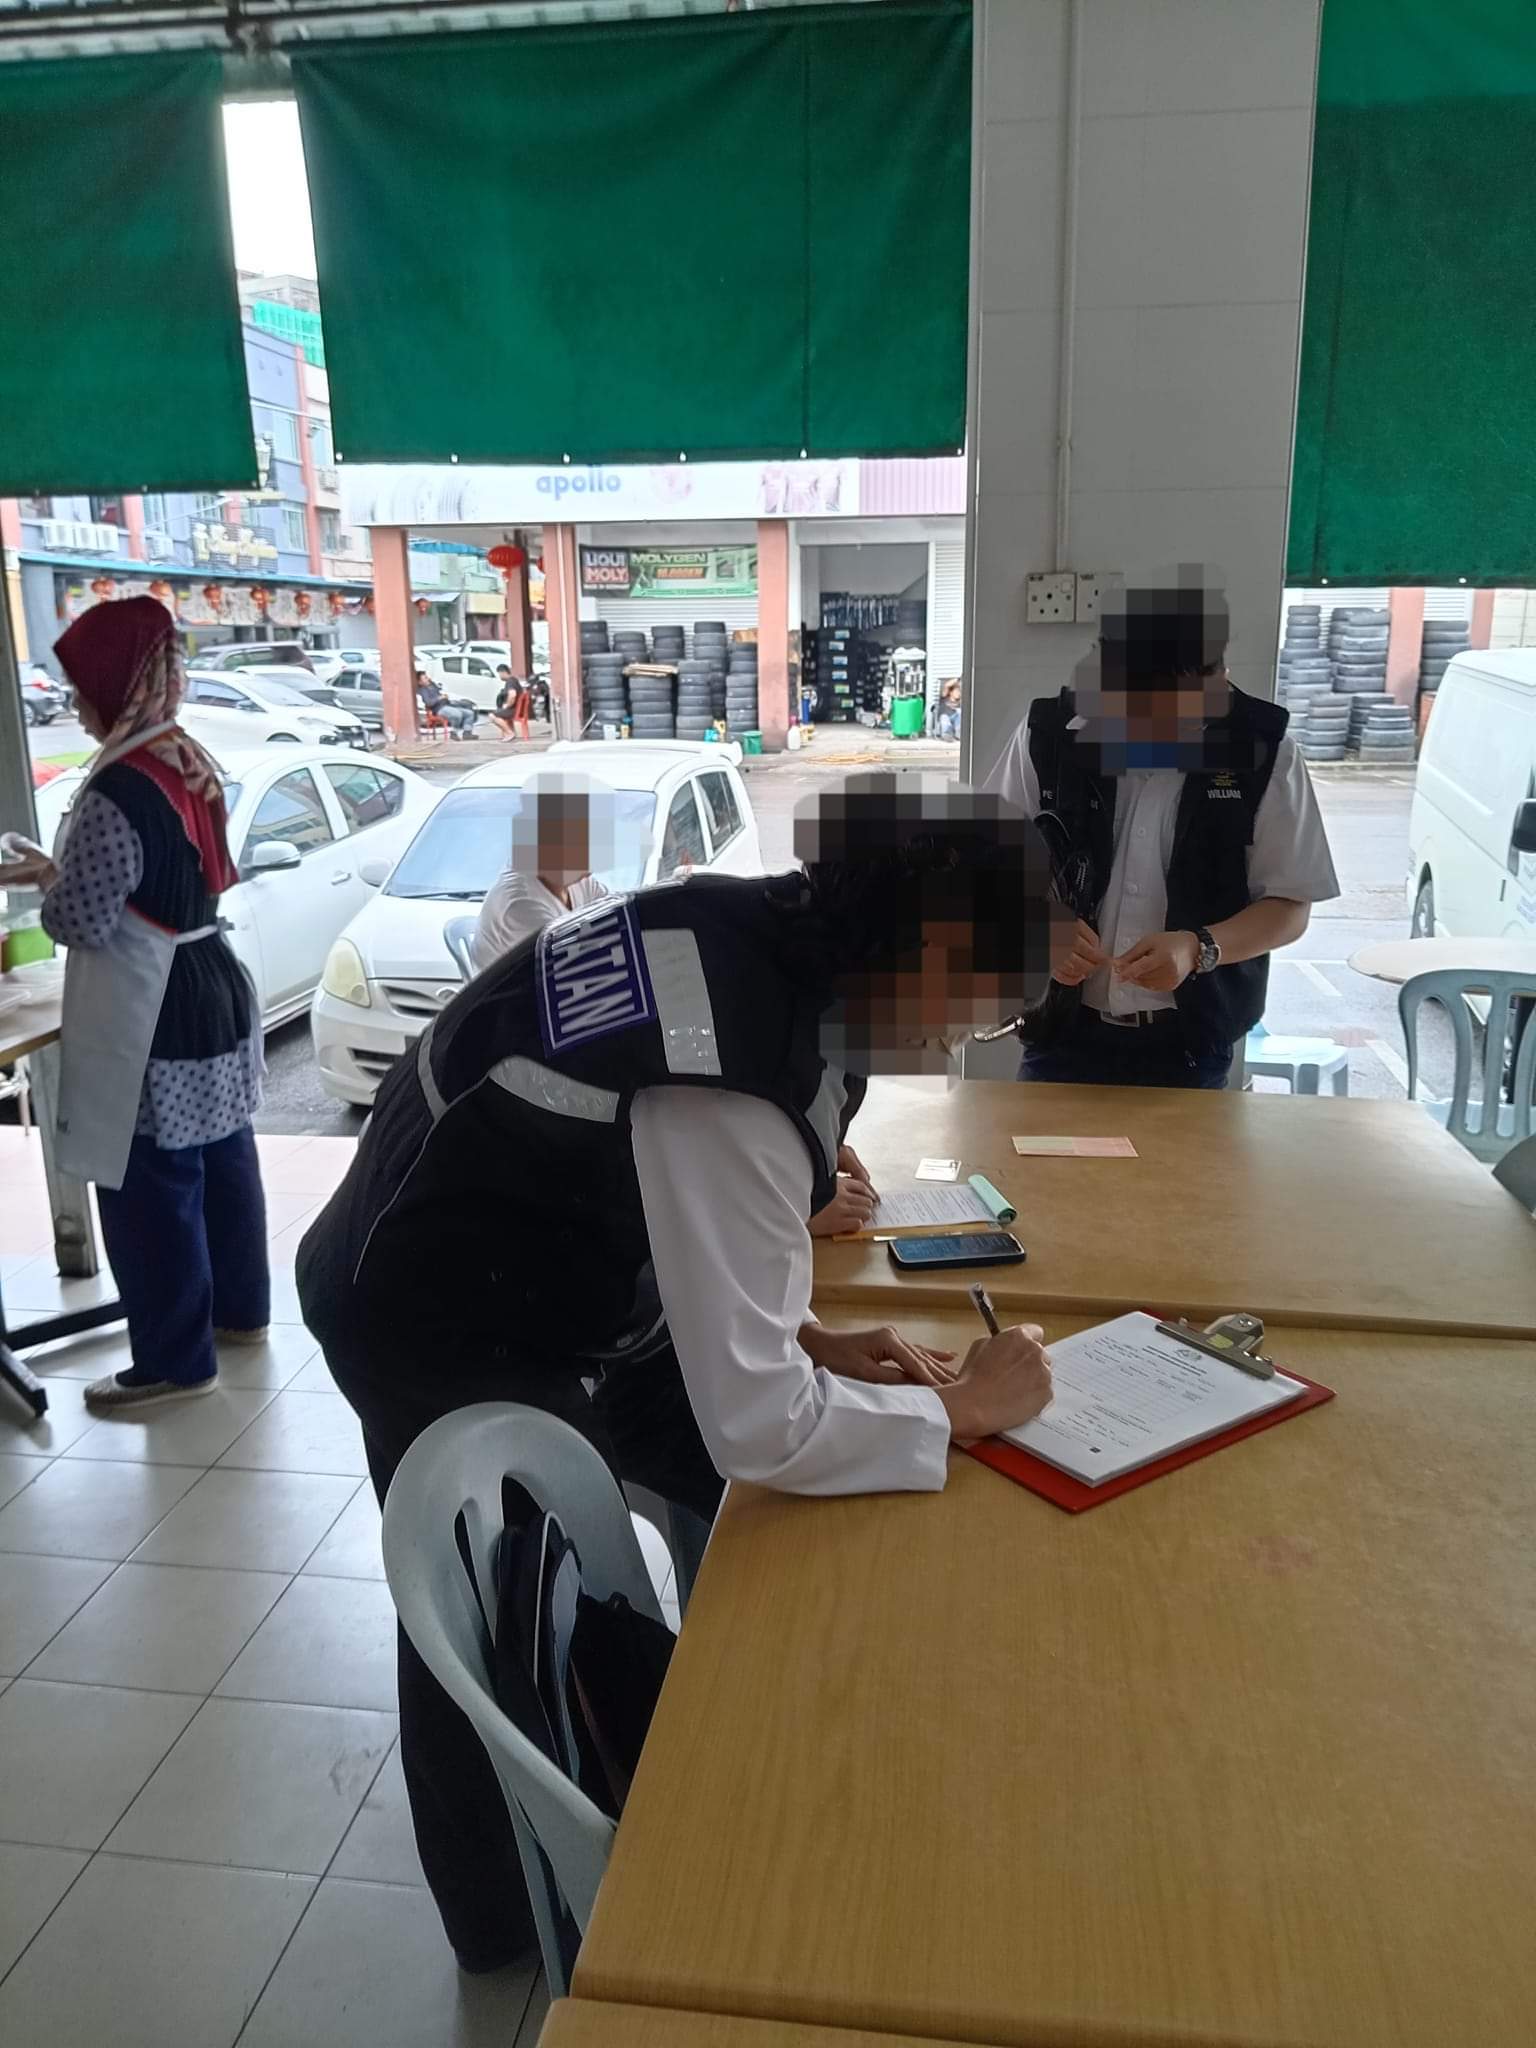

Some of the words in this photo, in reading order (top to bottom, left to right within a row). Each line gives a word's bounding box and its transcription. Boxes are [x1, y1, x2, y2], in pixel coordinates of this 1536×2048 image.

[536, 469, 622, 501] apollo
[585, 551, 626, 567] LIQUI
[630, 552, 706, 564] MOLYGEN
[584, 566, 630, 583] MOLY
[1207, 788, 1242, 800] WILLIAM
